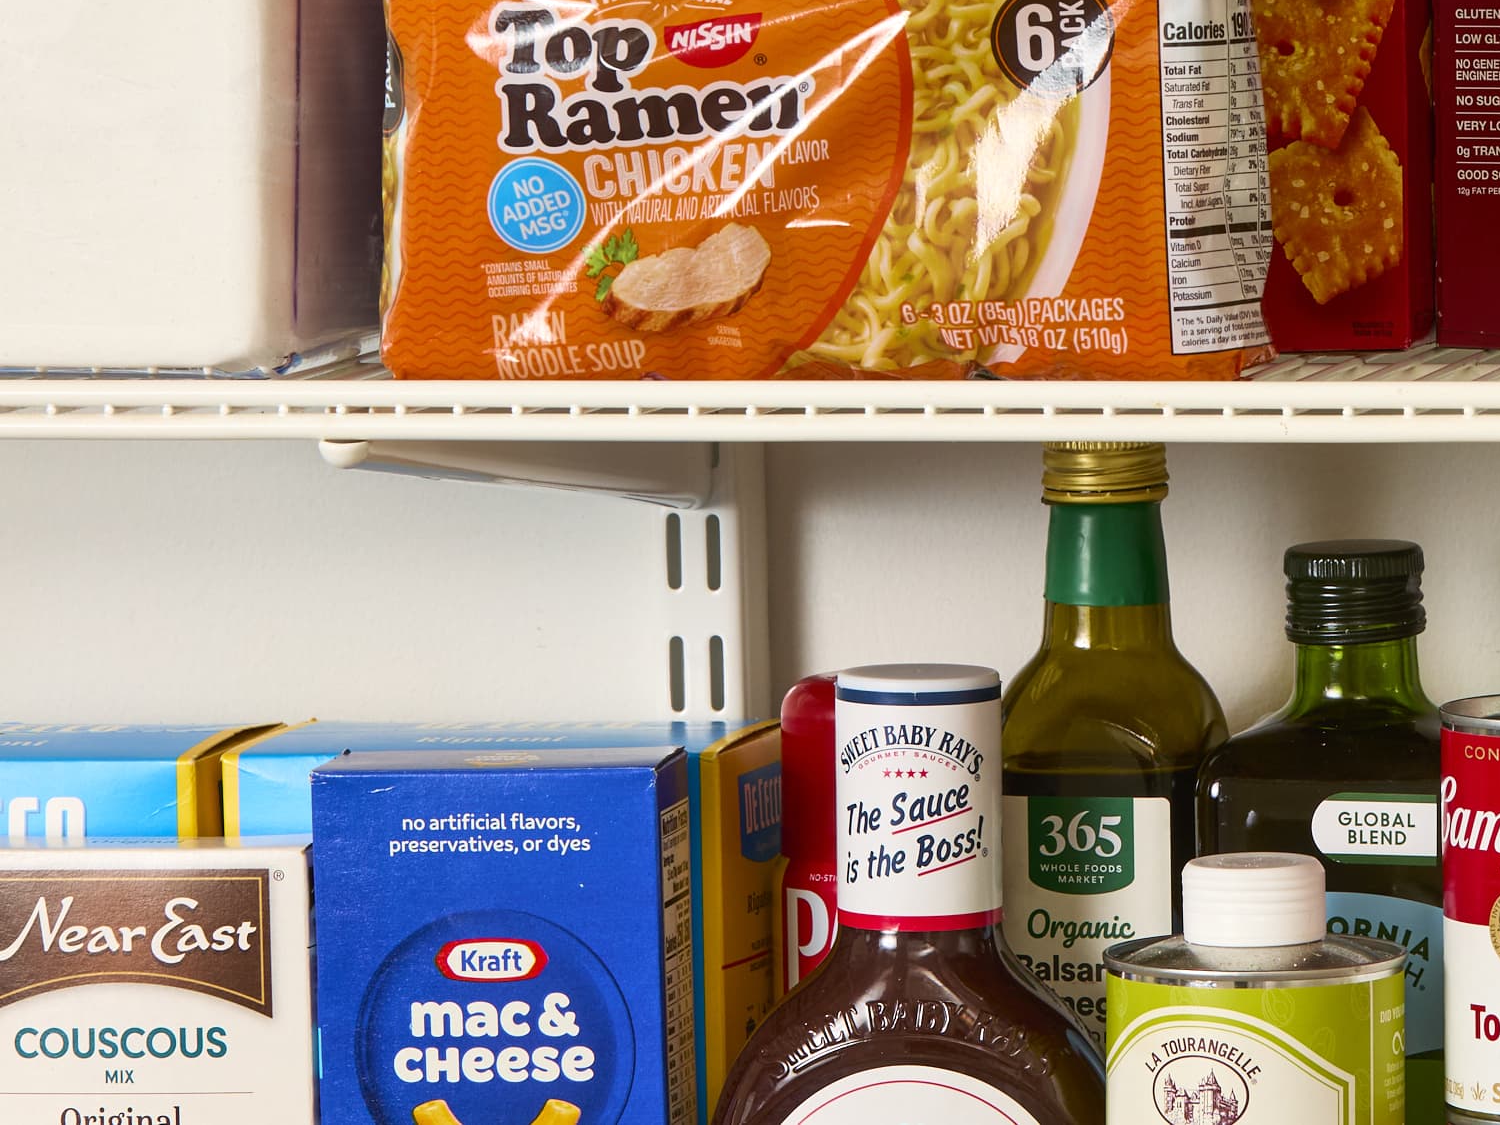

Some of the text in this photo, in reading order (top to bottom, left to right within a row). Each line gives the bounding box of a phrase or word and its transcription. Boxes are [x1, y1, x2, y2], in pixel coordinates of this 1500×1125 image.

[1455, 9, 1500, 19] GLUTEN
[672, 22, 751, 51] NISSIN
[1164, 21, 1225, 42] Calories
[1457, 147, 1470, 158] 0g
[512, 177, 543, 197] NO
[1457, 187, 1469, 196] 12g
[503, 190, 570, 222] ADDED
[1173, 288, 1212, 301] Potassium
[1030, 298, 1124, 322] PACKAGES
[848, 782, 968, 835] The Sauce
[402, 812, 580, 832] no artificial flavors,
[1338, 812, 1415, 828] GLOBAL
[389, 835, 590, 855] preservatives, or dyes
[1348, 830, 1407, 845] BLEND
[846, 815, 983, 883] is the Boss!
[1041, 864, 1122, 873] WHOLE FOODS
[1058, 875, 1104, 884] MARKET
[0, 896, 257, 964] Near East
[460, 948, 523, 972] Kraft
[410, 992, 578, 1038] mac &
[14, 1026, 227, 1059] COUSCOUS
[104, 1069, 134, 1083] MIX
